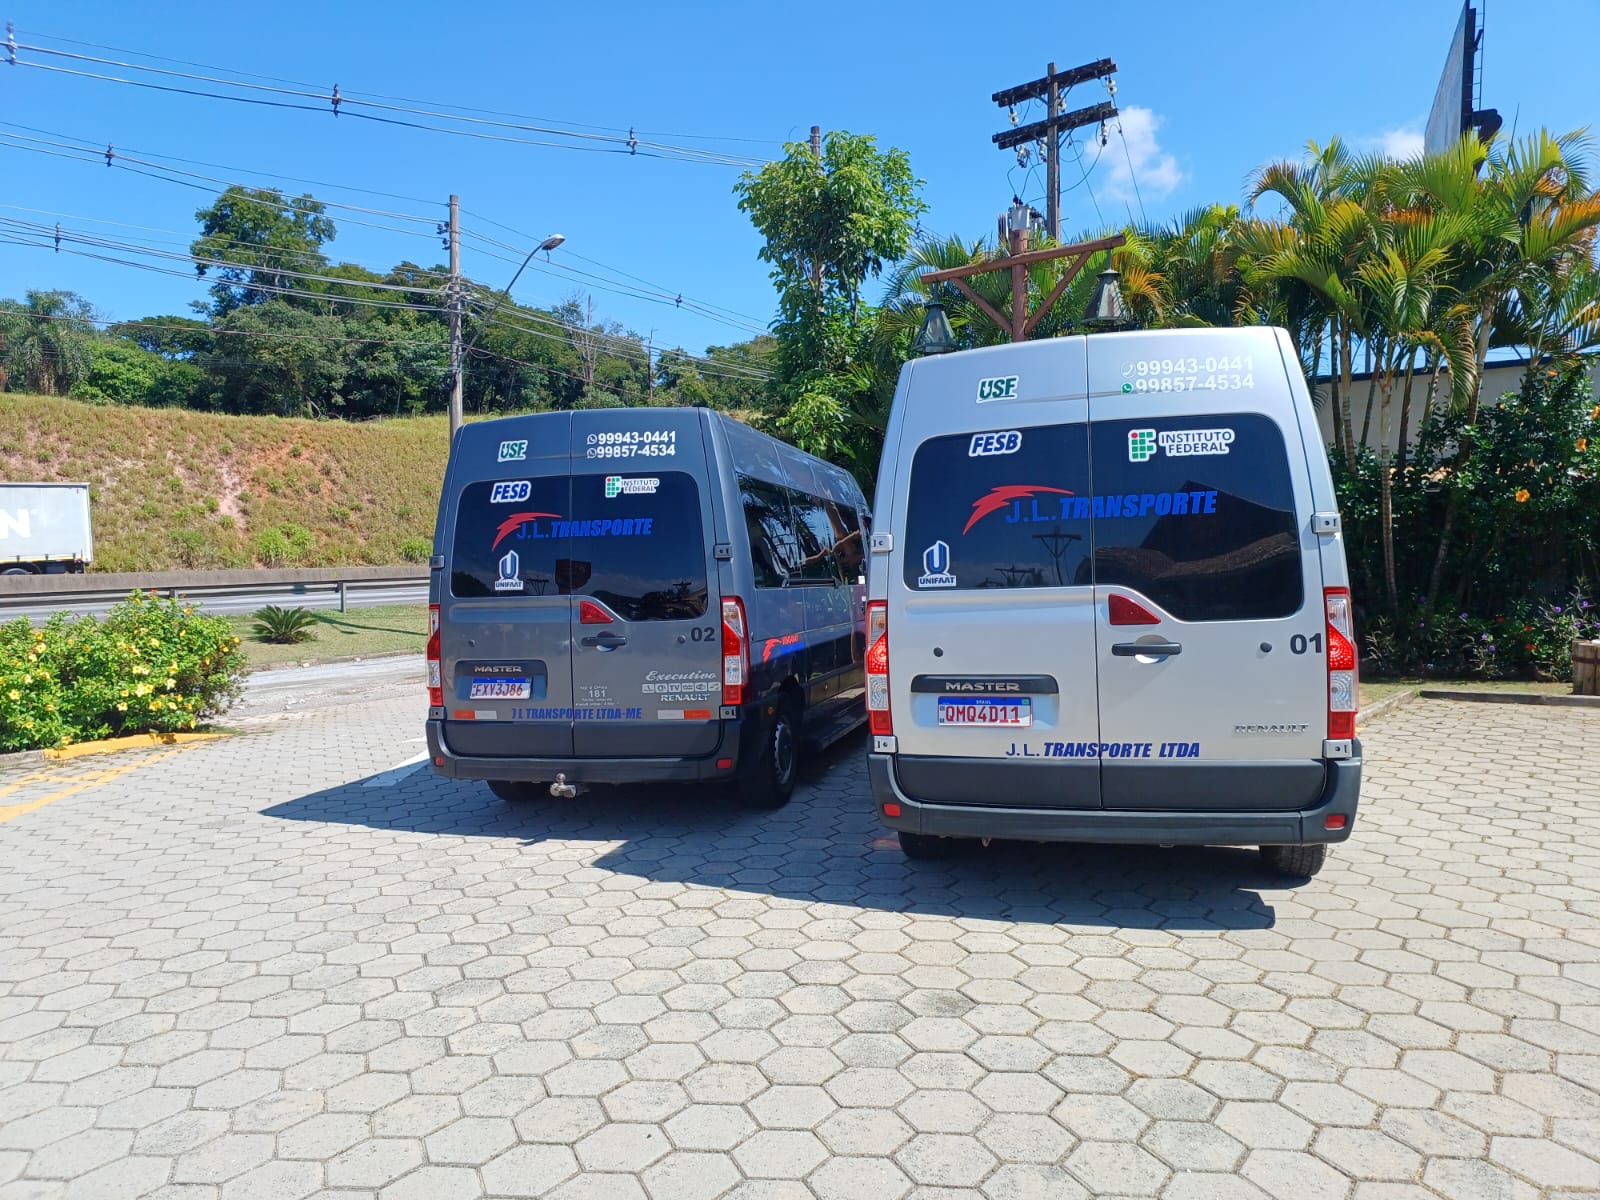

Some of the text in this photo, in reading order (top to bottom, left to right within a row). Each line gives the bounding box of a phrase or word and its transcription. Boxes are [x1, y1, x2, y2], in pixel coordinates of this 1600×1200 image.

[1136, 357, 1253, 376] 99943-0441
[1135, 374, 1254, 394] 99857-4534
[598, 431, 676, 444] 99943-0441
[971, 433, 1018, 454] FESB
[1161, 431, 1232, 444] INSTITUTO
[597, 444, 676, 458] 99857-4534
[1168, 444, 1226, 454] FEDERAL
[493, 484, 528, 500] FESB
[919, 577, 956, 585] UNIFAAT
[691, 627, 715, 642] 02
[1290, 633, 1321, 655] 01
[645, 670, 716, 681] Executivo
[945, 682, 1020, 691] MASTER
[589, 690, 606, 698] 181
[660, 694, 710, 702] RENAULT
[945, 705, 1020, 723] QMQ4D11
[1235, 724, 1309, 734] RENAULT
[1043, 741, 1152, 758] TRANSPORTE
[1158, 742, 1200, 758] LTDA
